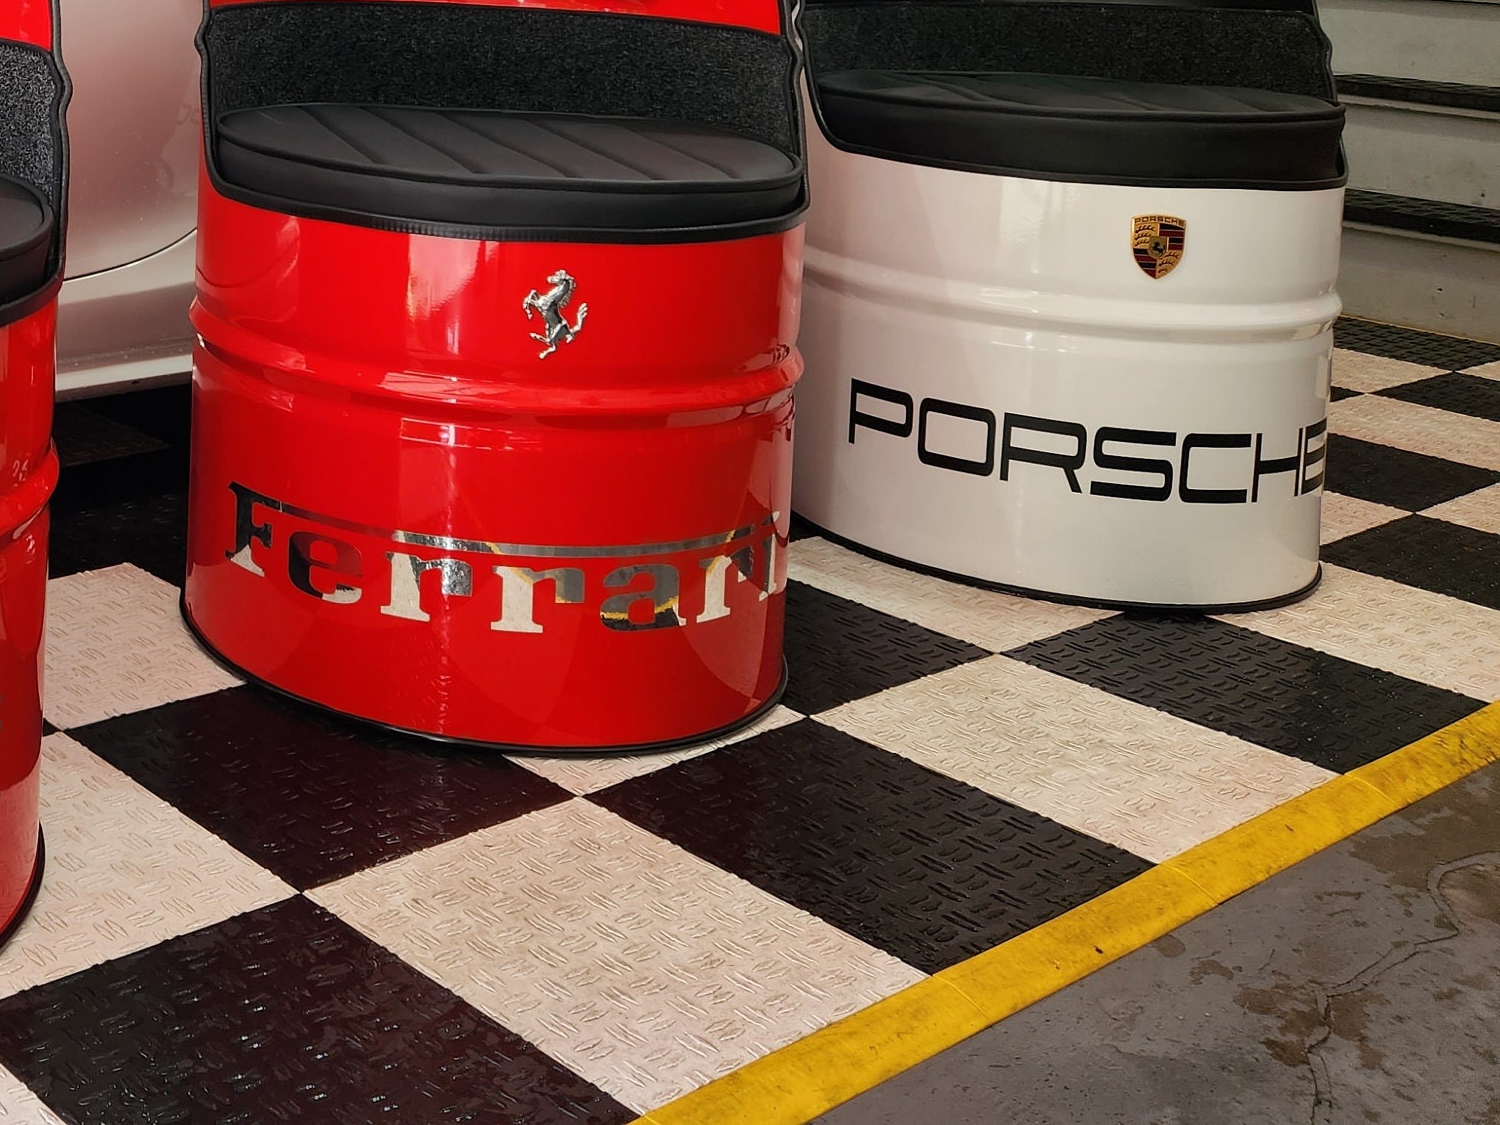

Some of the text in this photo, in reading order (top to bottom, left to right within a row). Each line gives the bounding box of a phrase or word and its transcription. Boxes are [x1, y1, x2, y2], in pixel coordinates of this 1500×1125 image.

[1134, 215, 1186, 226] PORSCHE
[848, 378, 1327, 504] PORSCHE
[225, 481, 781, 634] Ferrari
